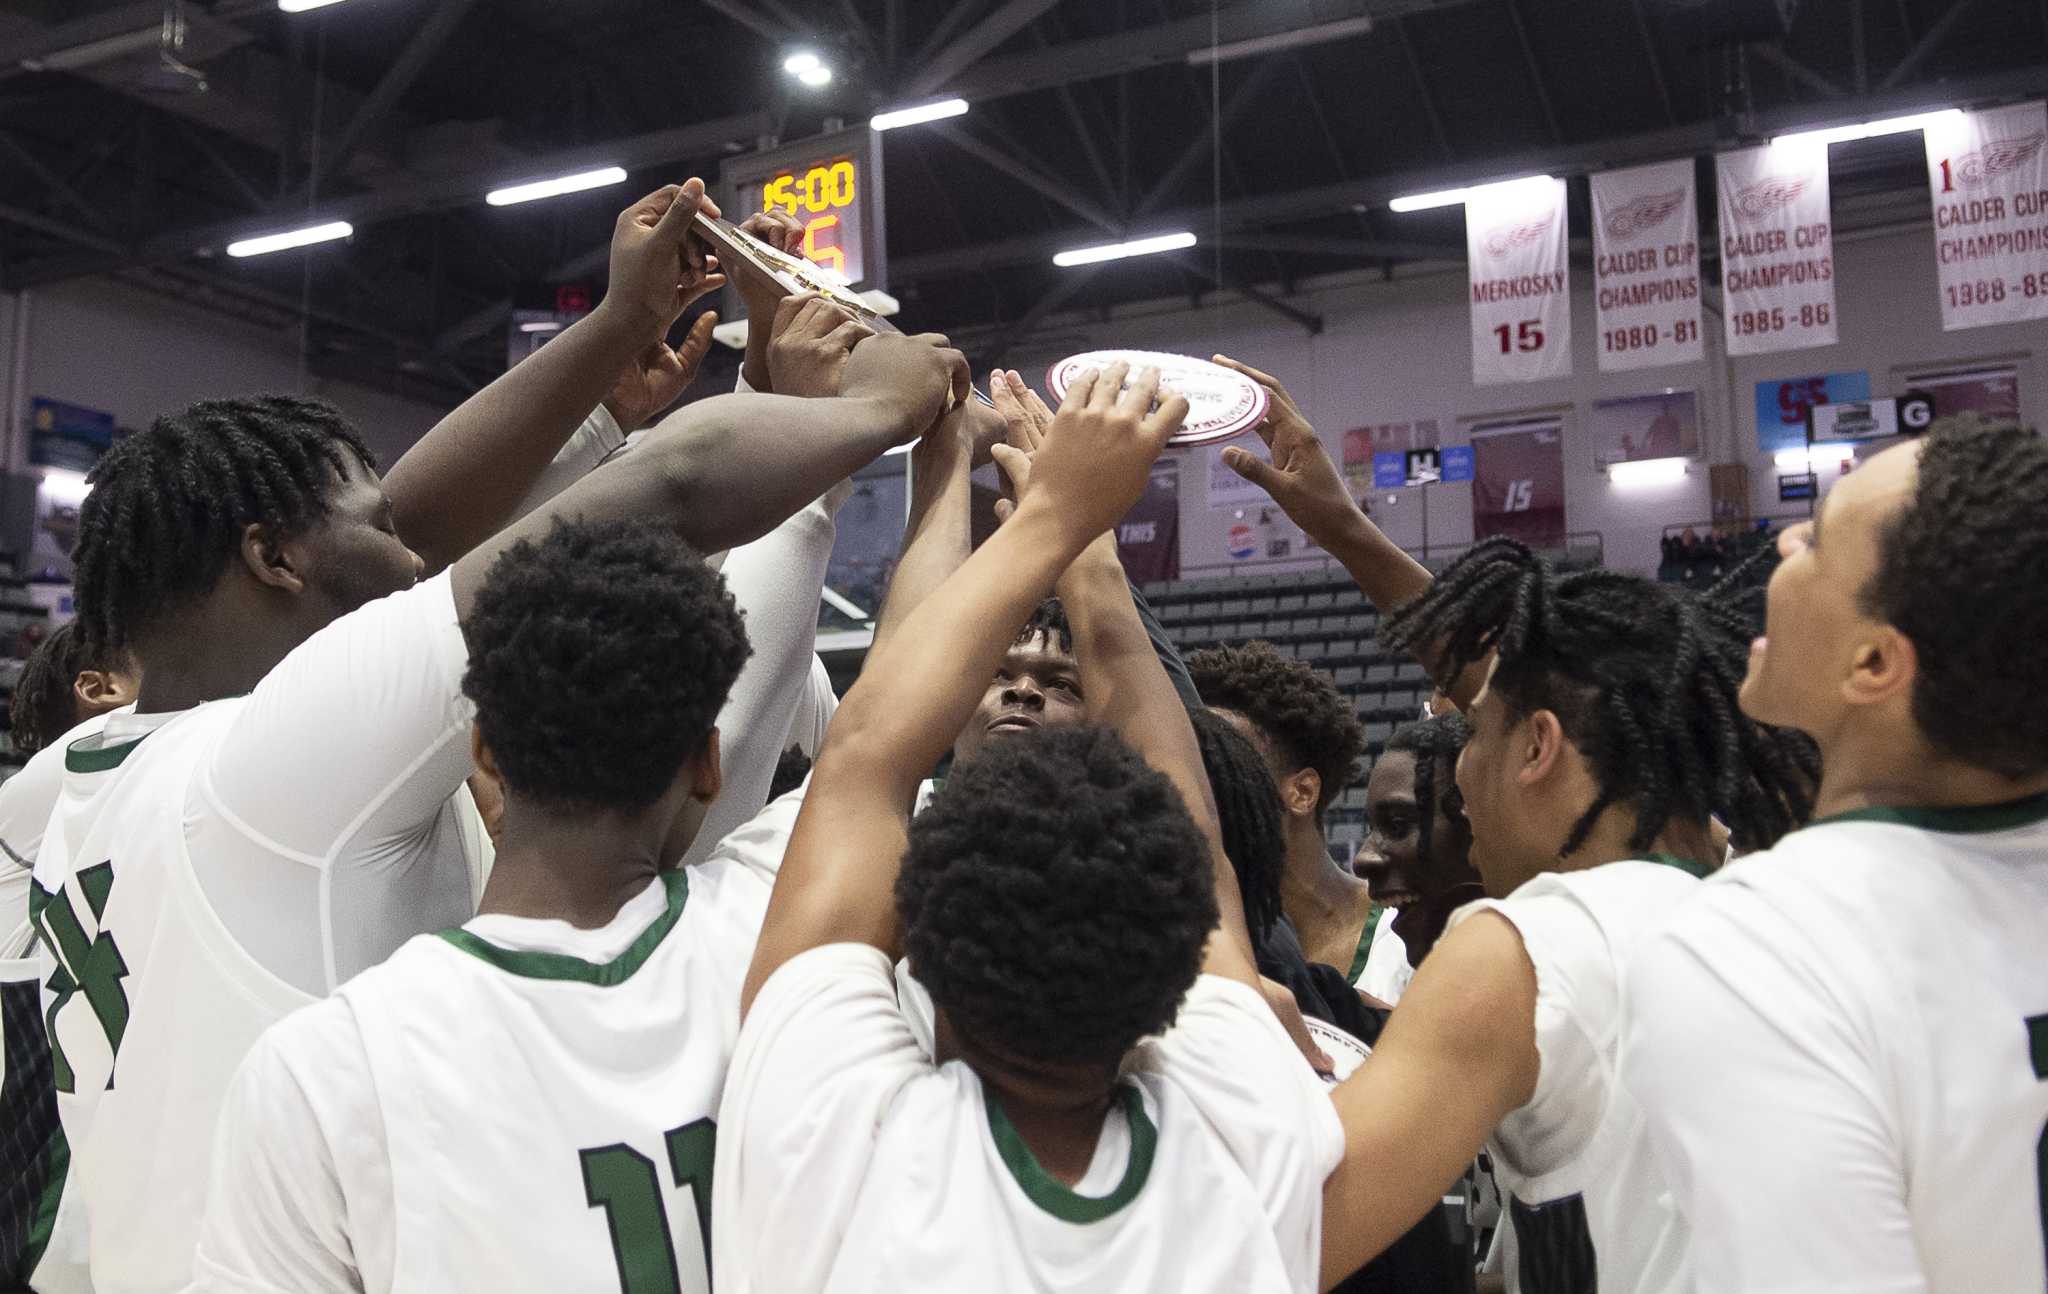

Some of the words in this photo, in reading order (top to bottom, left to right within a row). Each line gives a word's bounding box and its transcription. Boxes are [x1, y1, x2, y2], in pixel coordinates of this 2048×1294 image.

[764, 161, 855, 215] 15:00
[1940, 159, 1954, 192] 1
[1938, 197, 2005, 229] CALDER
[2015, 191, 2048, 217] CUP
[1725, 230, 1787, 259] CALDER
[1795, 224, 1828, 249] CUP
[1598, 248, 1658, 279] CALDER
[1663, 242, 1695, 268] CUP
[1727, 257, 1832, 293] CHAMPIONS
[1473, 271, 1565, 303] MERKOSKY
[1600, 276, 1697, 311] CHAMPIONS
[1494, 319, 1545, 355] 15
[1902, 400, 1931, 427] G
[1504, 479, 1533, 512] IS
[1120, 521, 1156, 544] THIS
